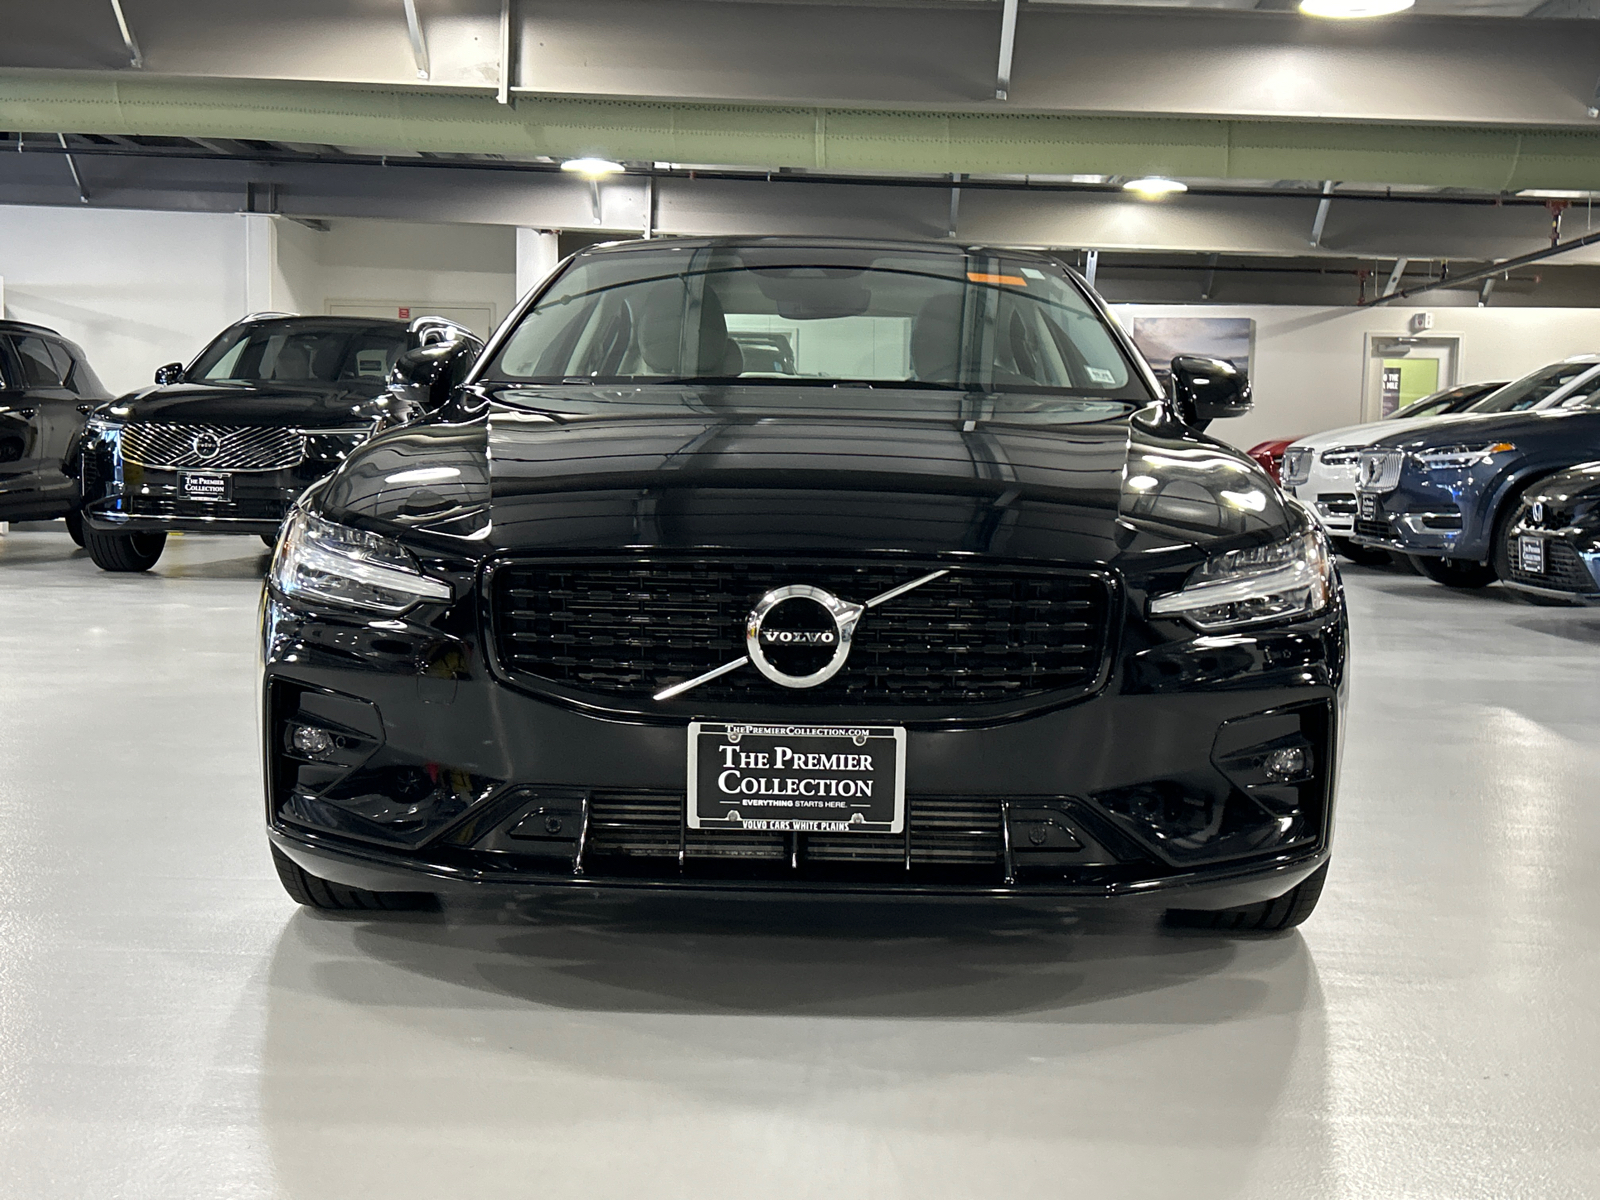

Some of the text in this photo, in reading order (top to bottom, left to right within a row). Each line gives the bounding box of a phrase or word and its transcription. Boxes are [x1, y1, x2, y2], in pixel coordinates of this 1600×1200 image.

[763, 631, 834, 642] VOLVO
[719, 745, 874, 771] THE PREMIER
[718, 770, 873, 796] COLLECTION
[742, 799, 794, 807] EVERYTHING
[825, 801, 848, 809] HERE.
[742, 820, 850, 831] VOLVO CARS WHITE PLAINS
